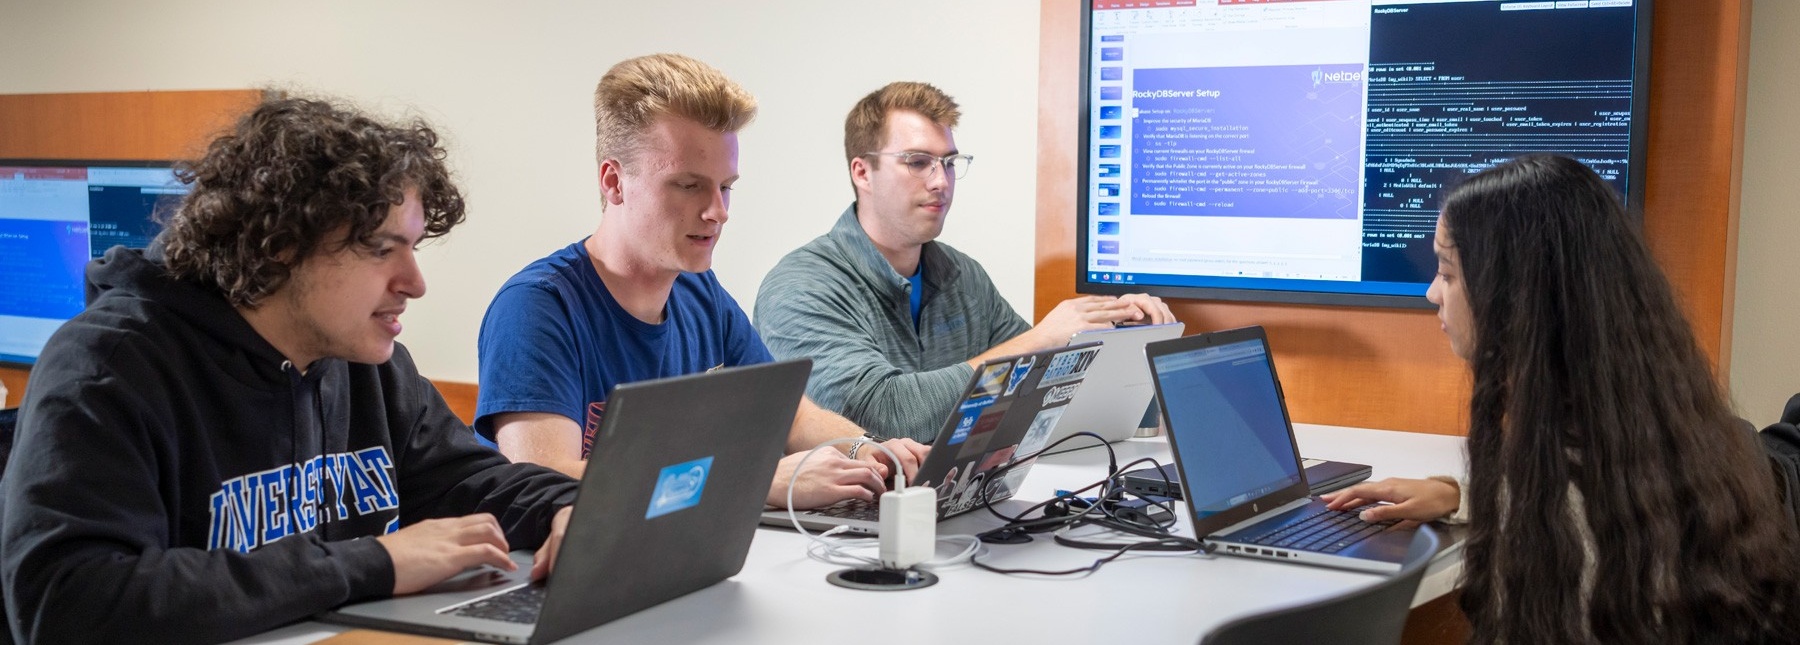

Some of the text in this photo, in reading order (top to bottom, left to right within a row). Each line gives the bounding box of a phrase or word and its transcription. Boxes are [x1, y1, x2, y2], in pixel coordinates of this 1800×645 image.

[1133, 89, 1220, 99] RockyDBServer Setup
[1069, 349, 1100, 374] XIV
